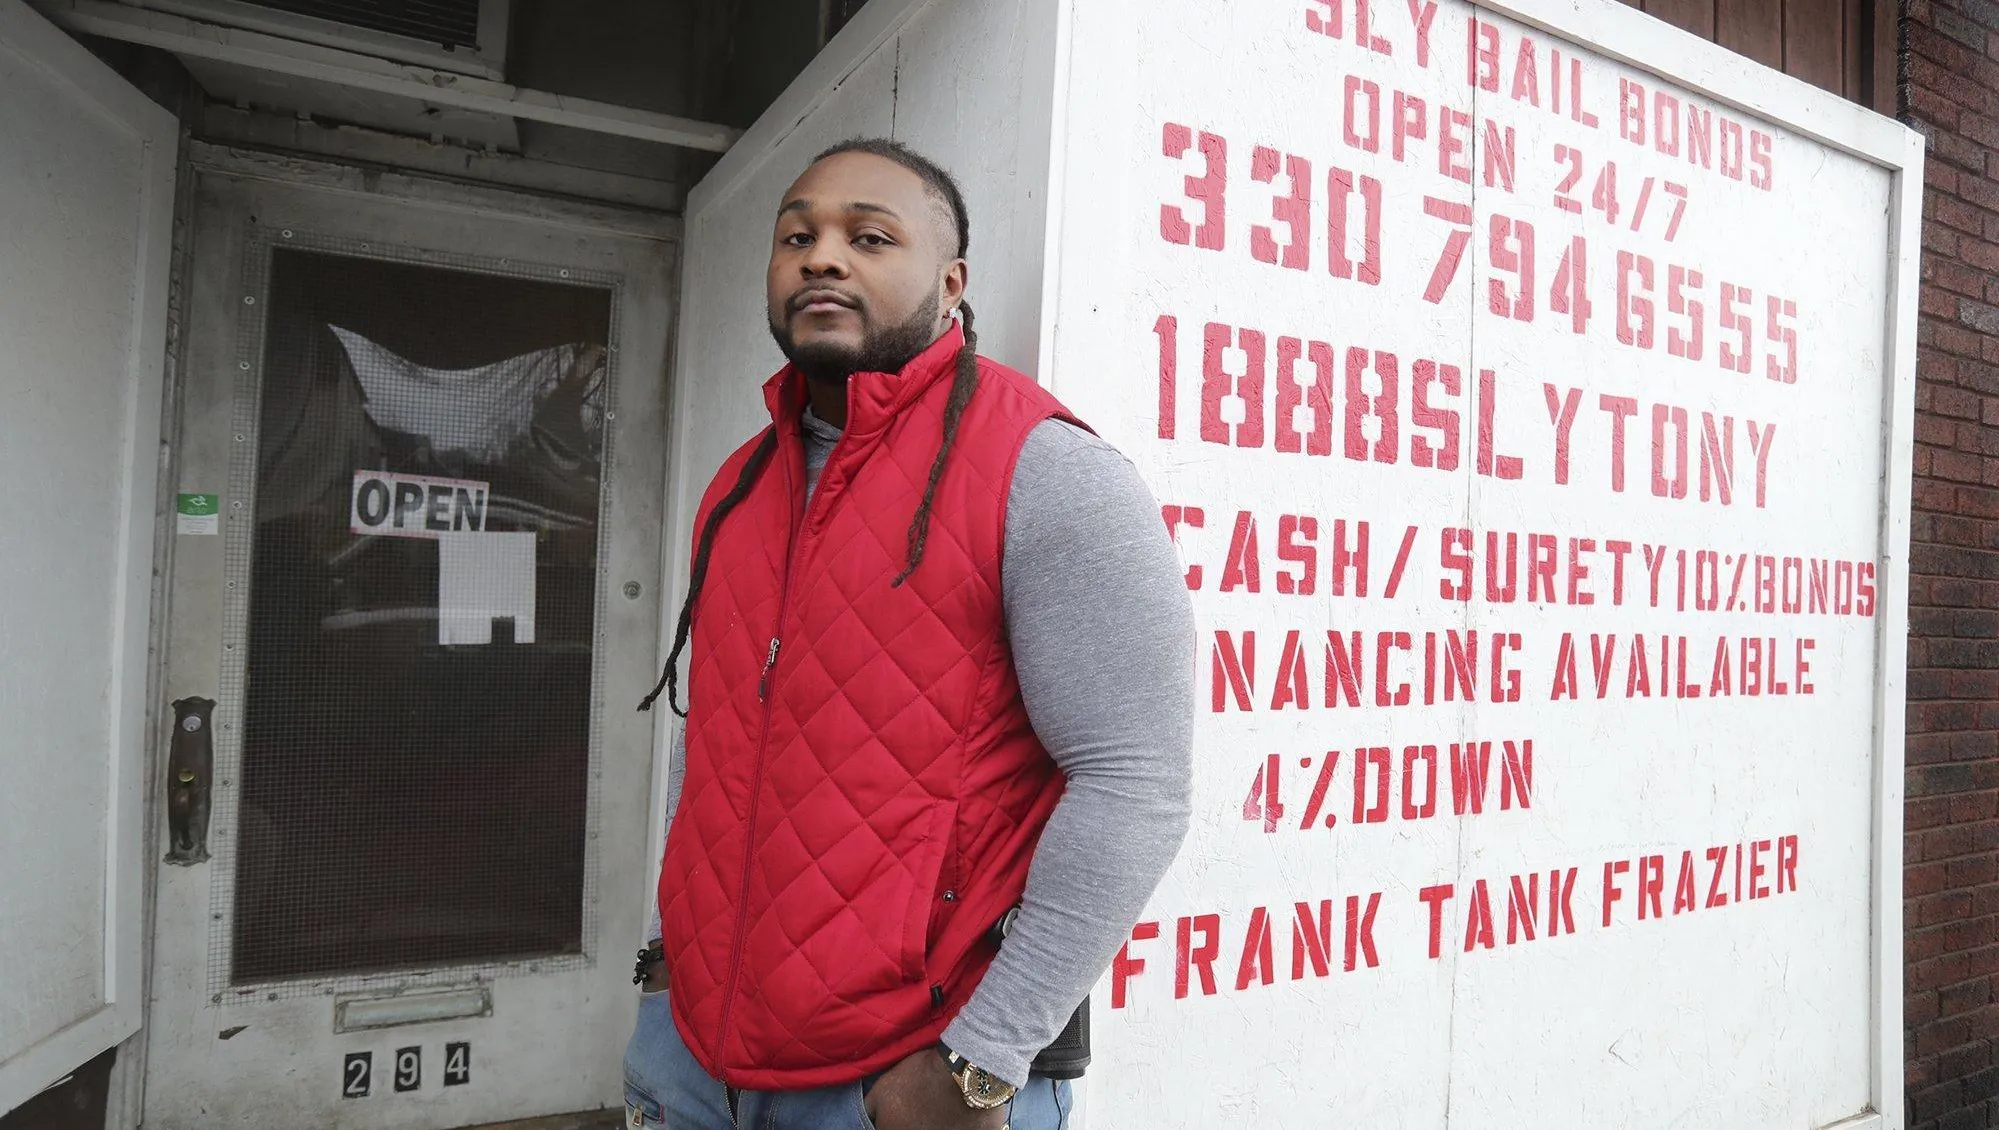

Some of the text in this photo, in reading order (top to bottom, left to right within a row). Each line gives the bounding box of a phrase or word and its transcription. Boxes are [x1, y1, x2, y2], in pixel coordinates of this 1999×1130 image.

[1343, 74, 1688, 242] OPEN 24/7
[1467, 16, 1600, 128] BAIL
[1619, 77, 1772, 192] BONDS
[1159, 122, 1797, 385] 330 794 6555
[357, 478, 484, 532] OPEN
[1550, 632, 1816, 702] AVAILABLE
[1111, 834, 1799, 1009] FRANK TANK FRAZIER
